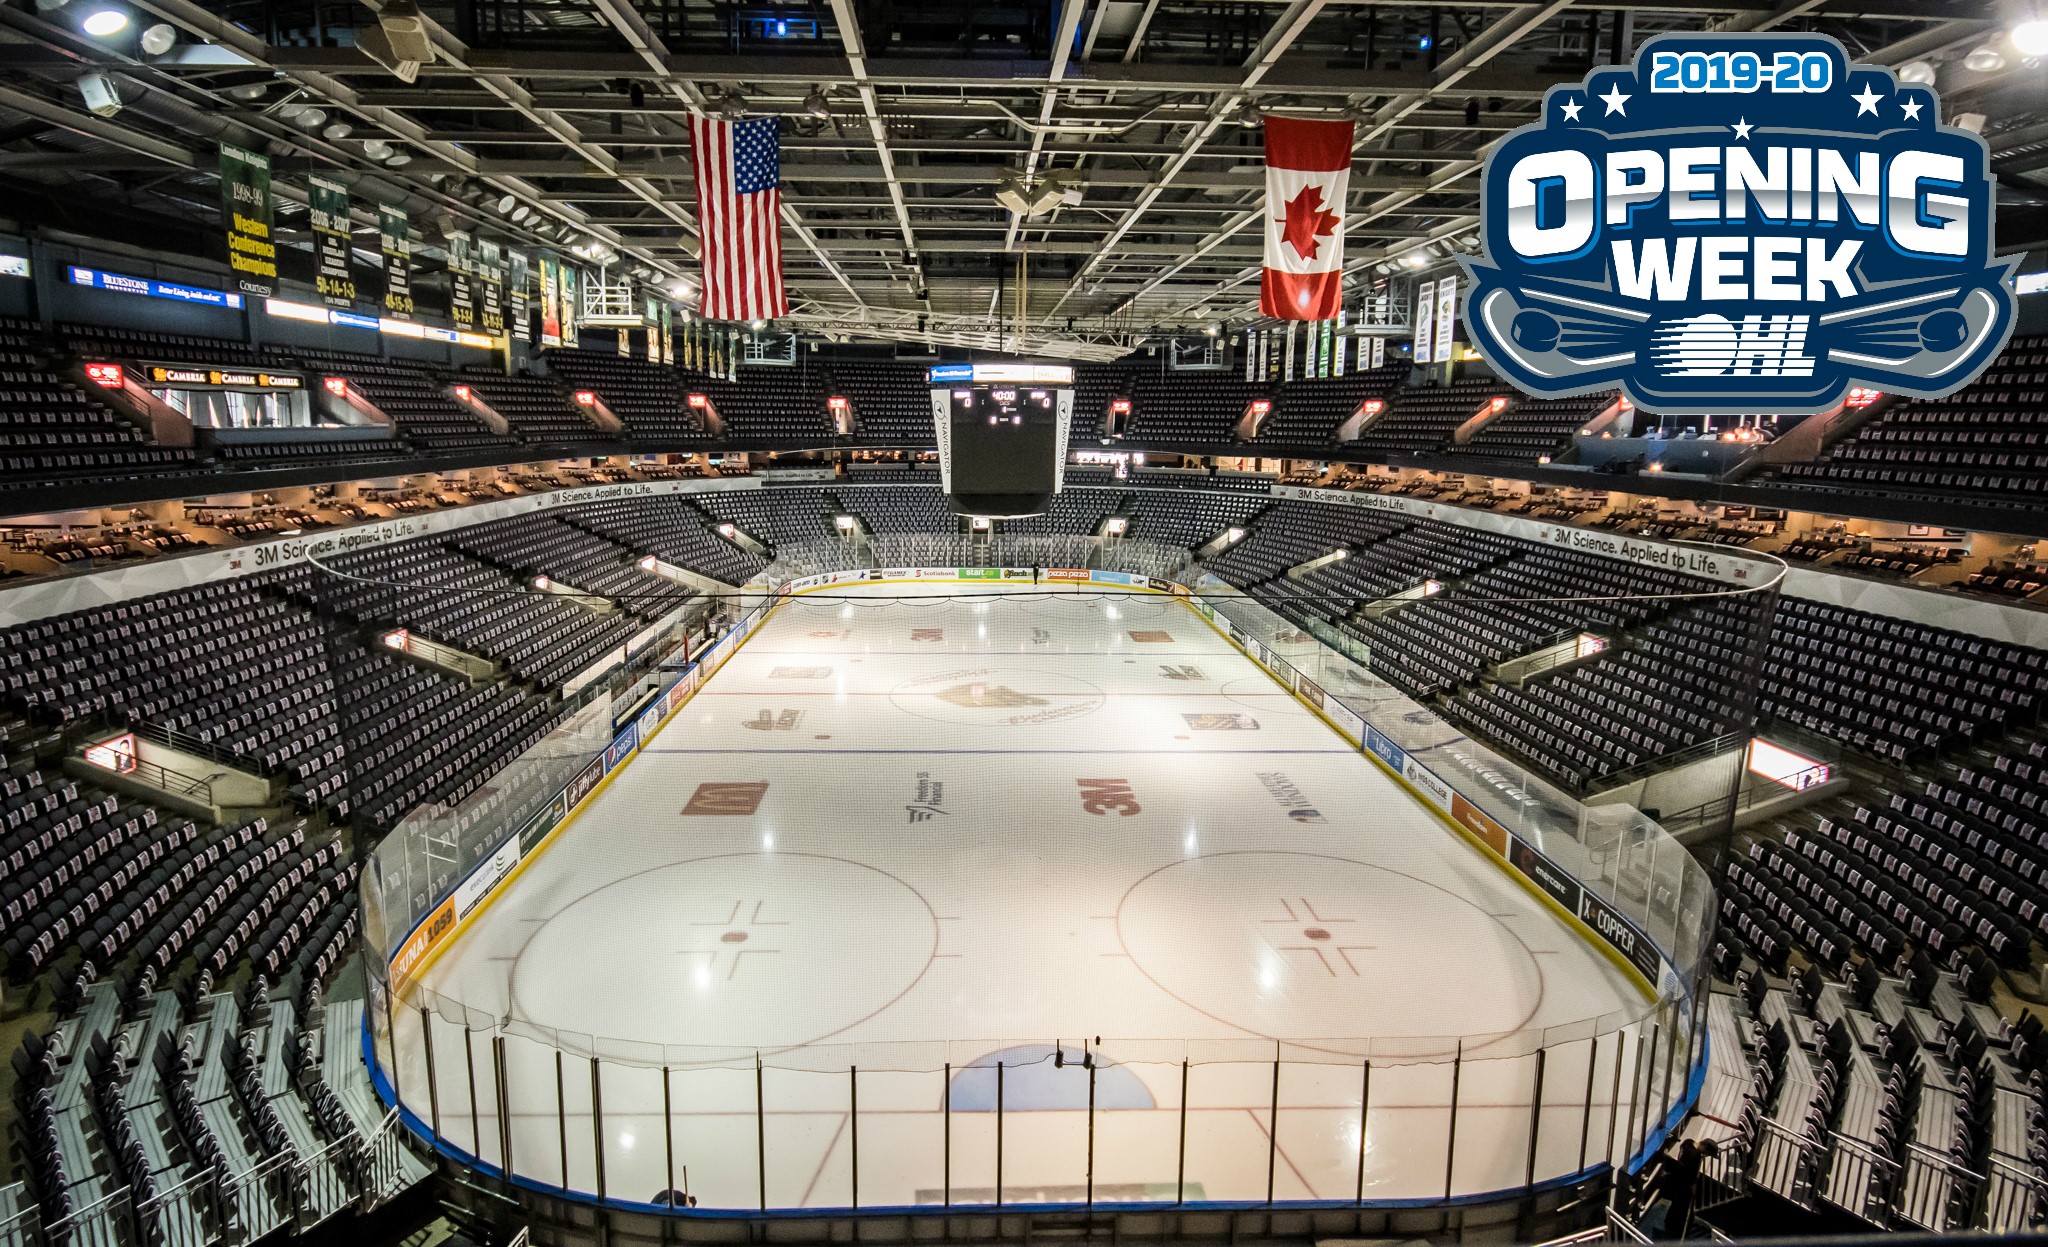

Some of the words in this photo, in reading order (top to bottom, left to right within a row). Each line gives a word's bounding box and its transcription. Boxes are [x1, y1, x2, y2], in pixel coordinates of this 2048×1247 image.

[220, 143, 244, 162] London
[245, 154, 268, 170] Knights
[232, 182, 264, 207] 1998-99
[232, 212, 269, 238] Western
[228, 231, 275, 259] Conference
[230, 251, 277, 278] Champions
[239, 280, 272, 297] Courtesy
[166, 370, 206, 383] CAMBRIA
[221, 374, 256, 385] CAMBRIA
[268, 376, 299, 387] CAMBRIA
[942, 422, 951, 475] NAVIGATOR
[1058, 422, 1068, 475] NAVIGATOR
[562, 491, 593, 503] Science.
[595, 488, 622, 500] Applied
[624, 487, 633, 496] to
[635, 484, 653, 495] Life.
[1297, 489, 1313, 500] 3M
[1314, 491, 1348, 503] Science.
[1350, 495, 1378, 508] Applied
[1380, 497, 1387, 507] to
[1389, 499, 1405, 510] Life.
[255, 546, 279, 566] 3M
[282, 538, 336, 561] Science.
[338, 526, 380, 549] Applied
[381, 526, 392, 545] to
[394, 521, 414, 537] Life.
[1554, 528, 1571, 545] 3M
[1573, 532, 1618, 554] Science.
[1620, 541, 1668, 565] Applied
[1672, 552, 1686, 568] to
[1689, 554, 1719, 576] Life.
[229, 559, 242, 570] 3M
[1733, 568, 1747, 579] 3M
[616, 735, 632, 758] pepsi
[1076, 778, 1142, 816] 3M
[1535, 865, 1567, 894] enercare
[1584, 898, 1592, 920] X
[1597, 909, 1635, 956] COPPER
